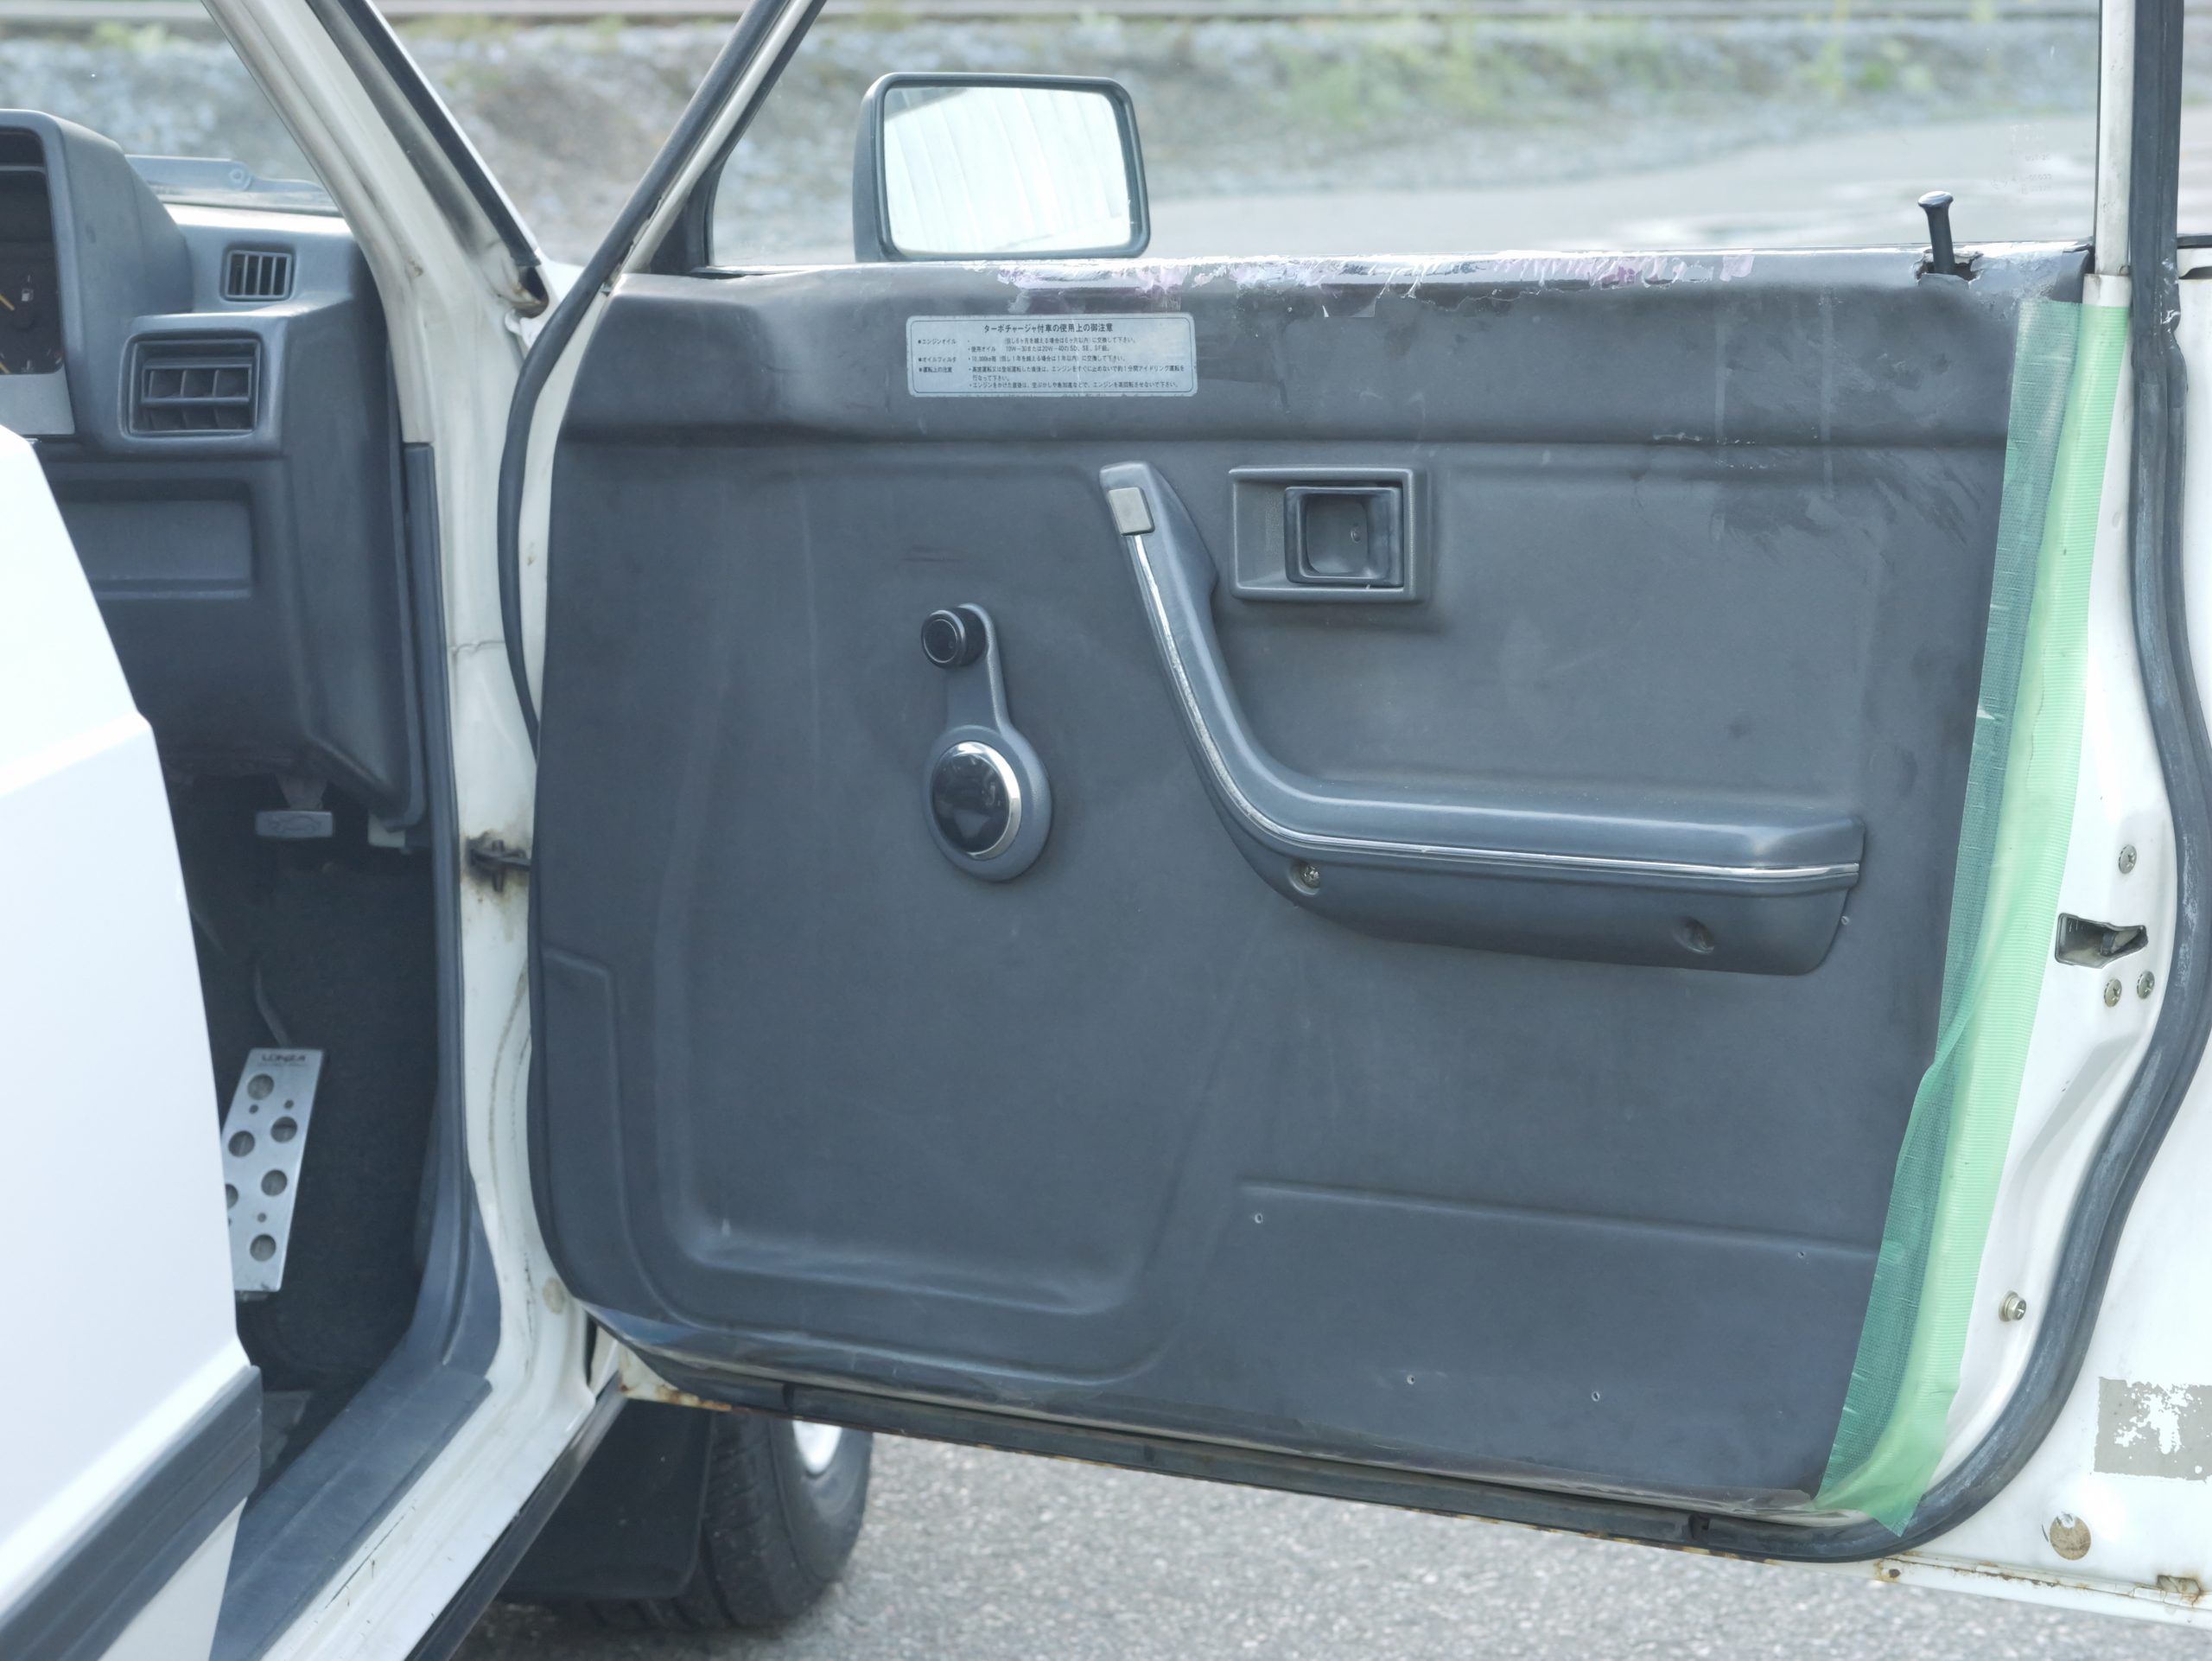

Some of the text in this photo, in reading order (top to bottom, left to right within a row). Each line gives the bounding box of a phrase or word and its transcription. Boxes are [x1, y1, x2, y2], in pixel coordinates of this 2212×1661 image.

[984, 323, 1113, 333] ターボチャージャ付車の使用上の御注意
